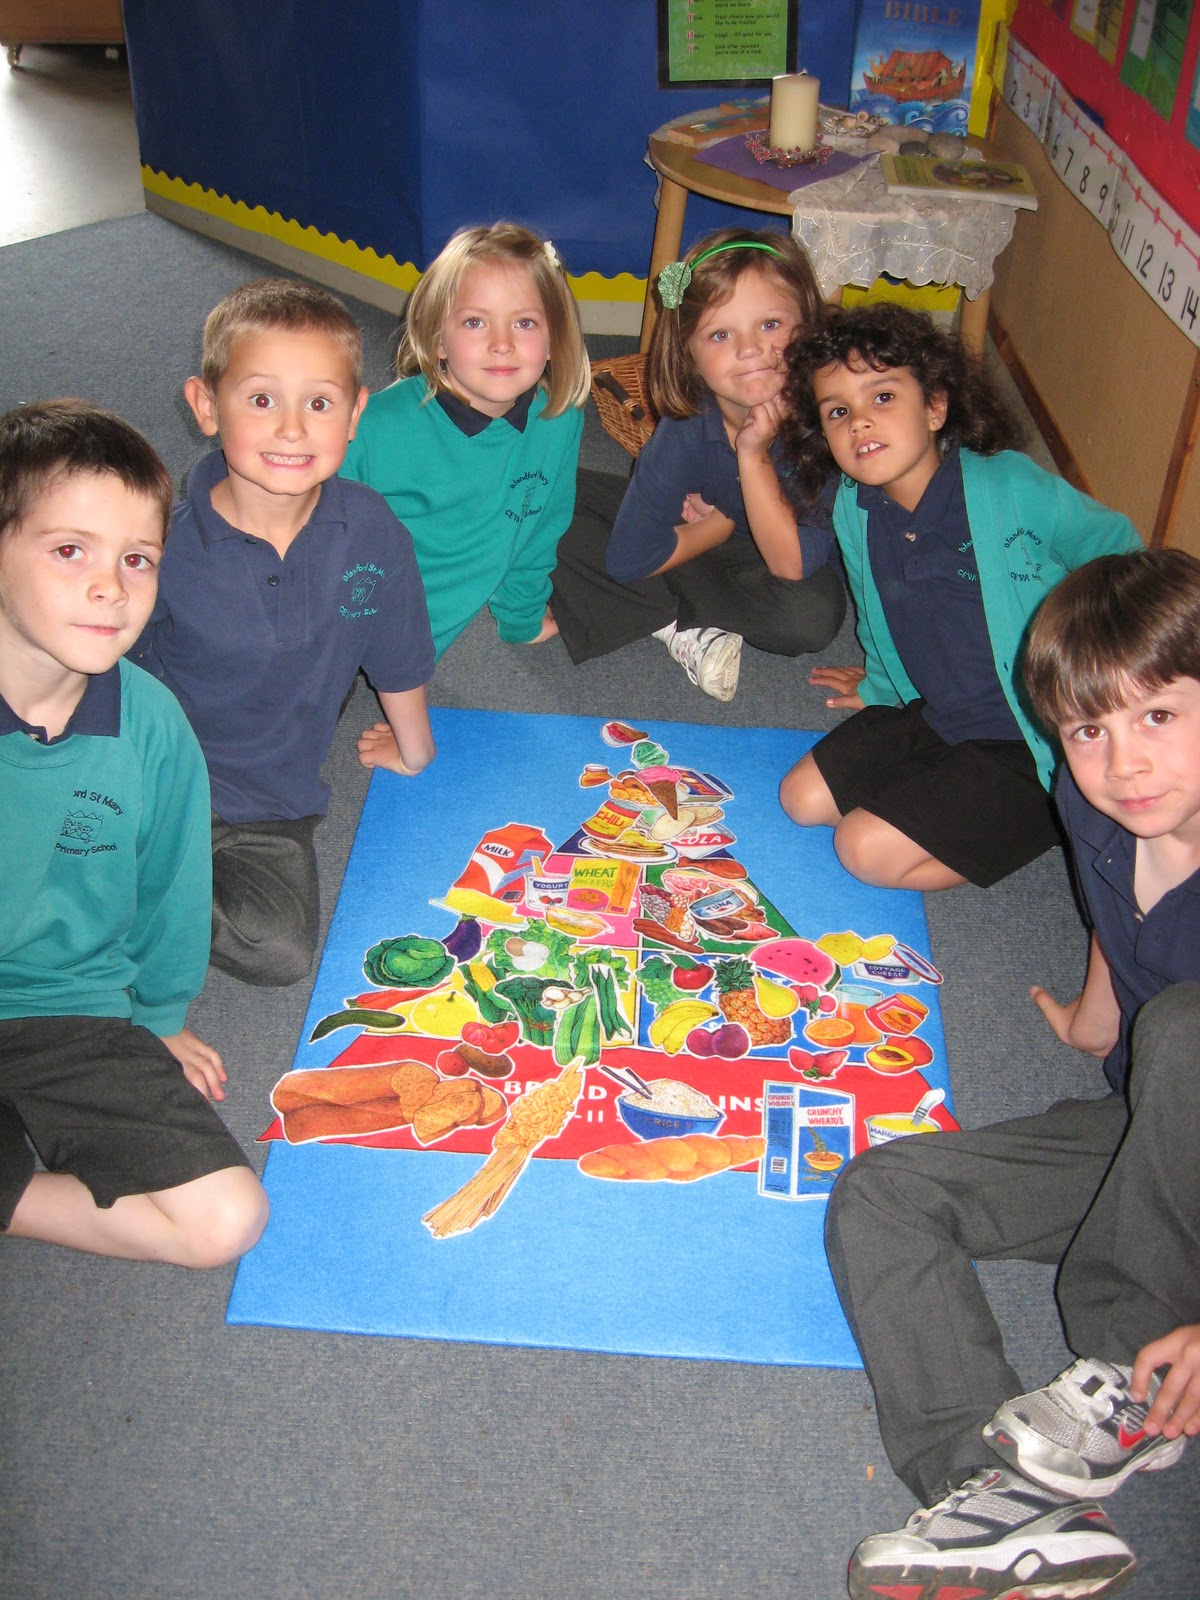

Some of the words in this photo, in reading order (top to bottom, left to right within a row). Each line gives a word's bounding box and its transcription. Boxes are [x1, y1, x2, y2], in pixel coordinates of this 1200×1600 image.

[884, 0, 963, 28] BIBLE
[1009, 79, 1019, 107] 2
[1022, 92, 1032, 119] 3
[1051, 131, 1061, 161] 6
[1062, 146, 1075, 177] 7
[1079, 165, 1091, 194] 8
[1098, 183, 1109, 214] 9
[1119, 218, 1135, 256] 11
[1135, 238, 1154, 280] 12
[1157, 260, 1176, 303] 13
[1180, 285, 1200, 331] 14
[89, 791, 102, 803] St
[102, 796, 123, 816] Mary
[677, 834, 723, 846] COLA
[55, 843, 90, 857] Primary
[91, 843, 118, 854] School
[483, 843, 511, 858] MILK
[574, 866, 619, 879] WHEAT
[534, 881, 570, 890] YOGURT
[706, 900, 733, 912] TUNA
[868, 965, 907, 974] COTTAGE
[871, 970, 905, 978] CHEESE
[806, 1106, 845, 1116] CRUNCHY
[653, 1118, 681, 1129] RICE
[807, 1116, 845, 1126] WHEATO'S
